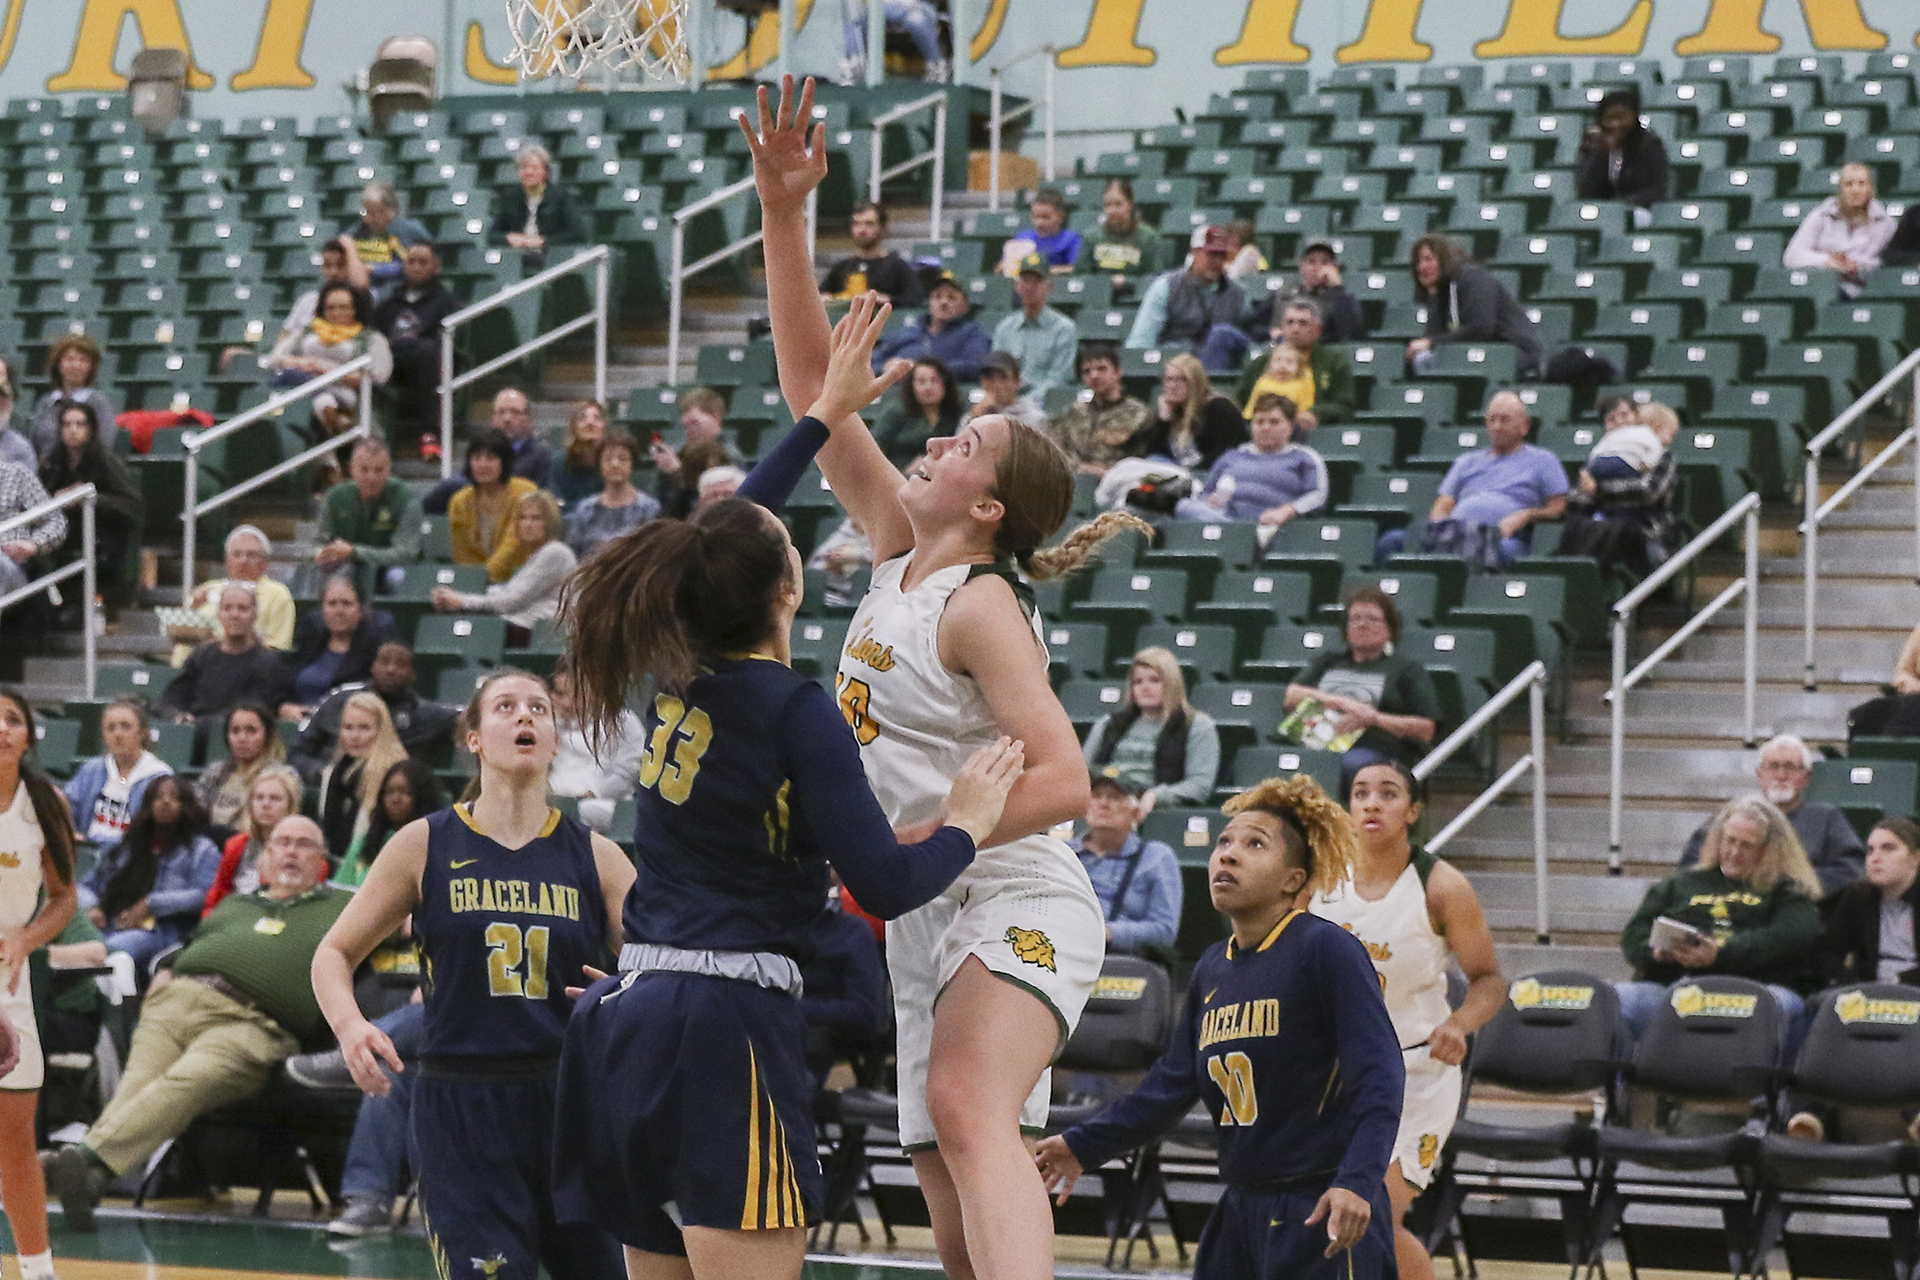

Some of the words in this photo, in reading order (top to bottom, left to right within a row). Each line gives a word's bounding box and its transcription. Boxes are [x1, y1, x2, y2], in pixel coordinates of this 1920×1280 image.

[639, 692, 714, 806] 33
[449, 877, 580, 922] GRACELAND
[484, 921, 550, 1000] 21
